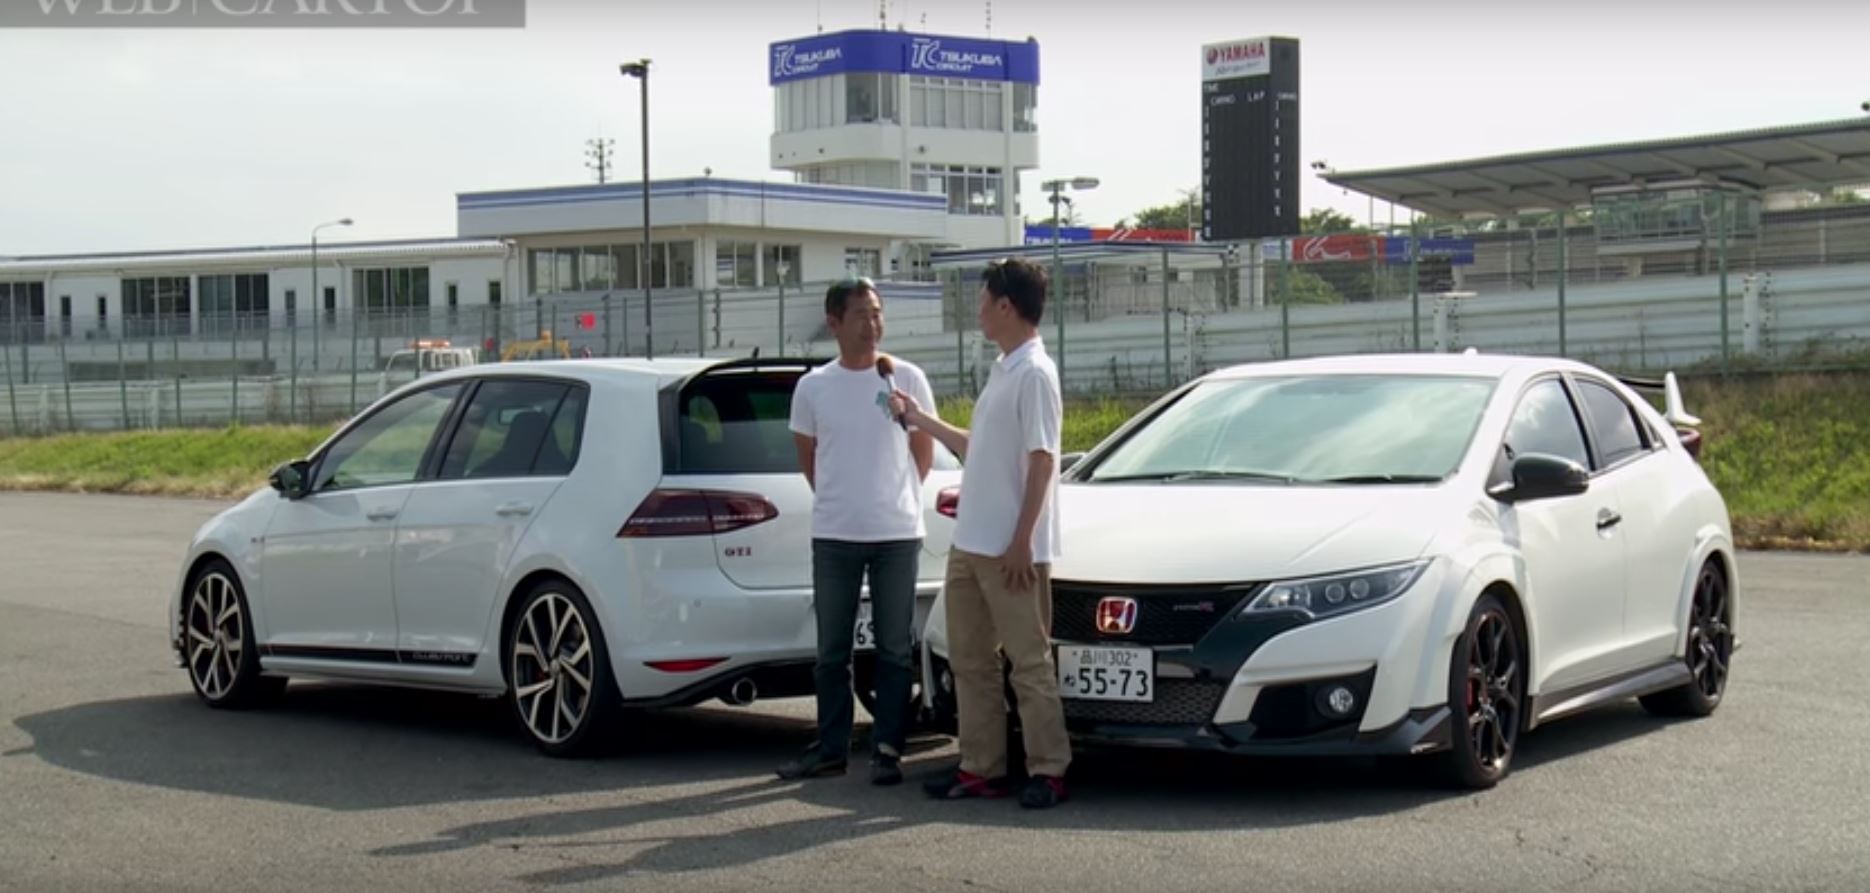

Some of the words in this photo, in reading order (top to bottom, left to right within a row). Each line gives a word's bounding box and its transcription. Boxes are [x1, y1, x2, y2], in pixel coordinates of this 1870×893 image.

[940, 51, 1002, 66] TSUKUBA
[1220, 42, 1265, 62] YAMAHA
[1079, 668, 1148, 696] 55-73
